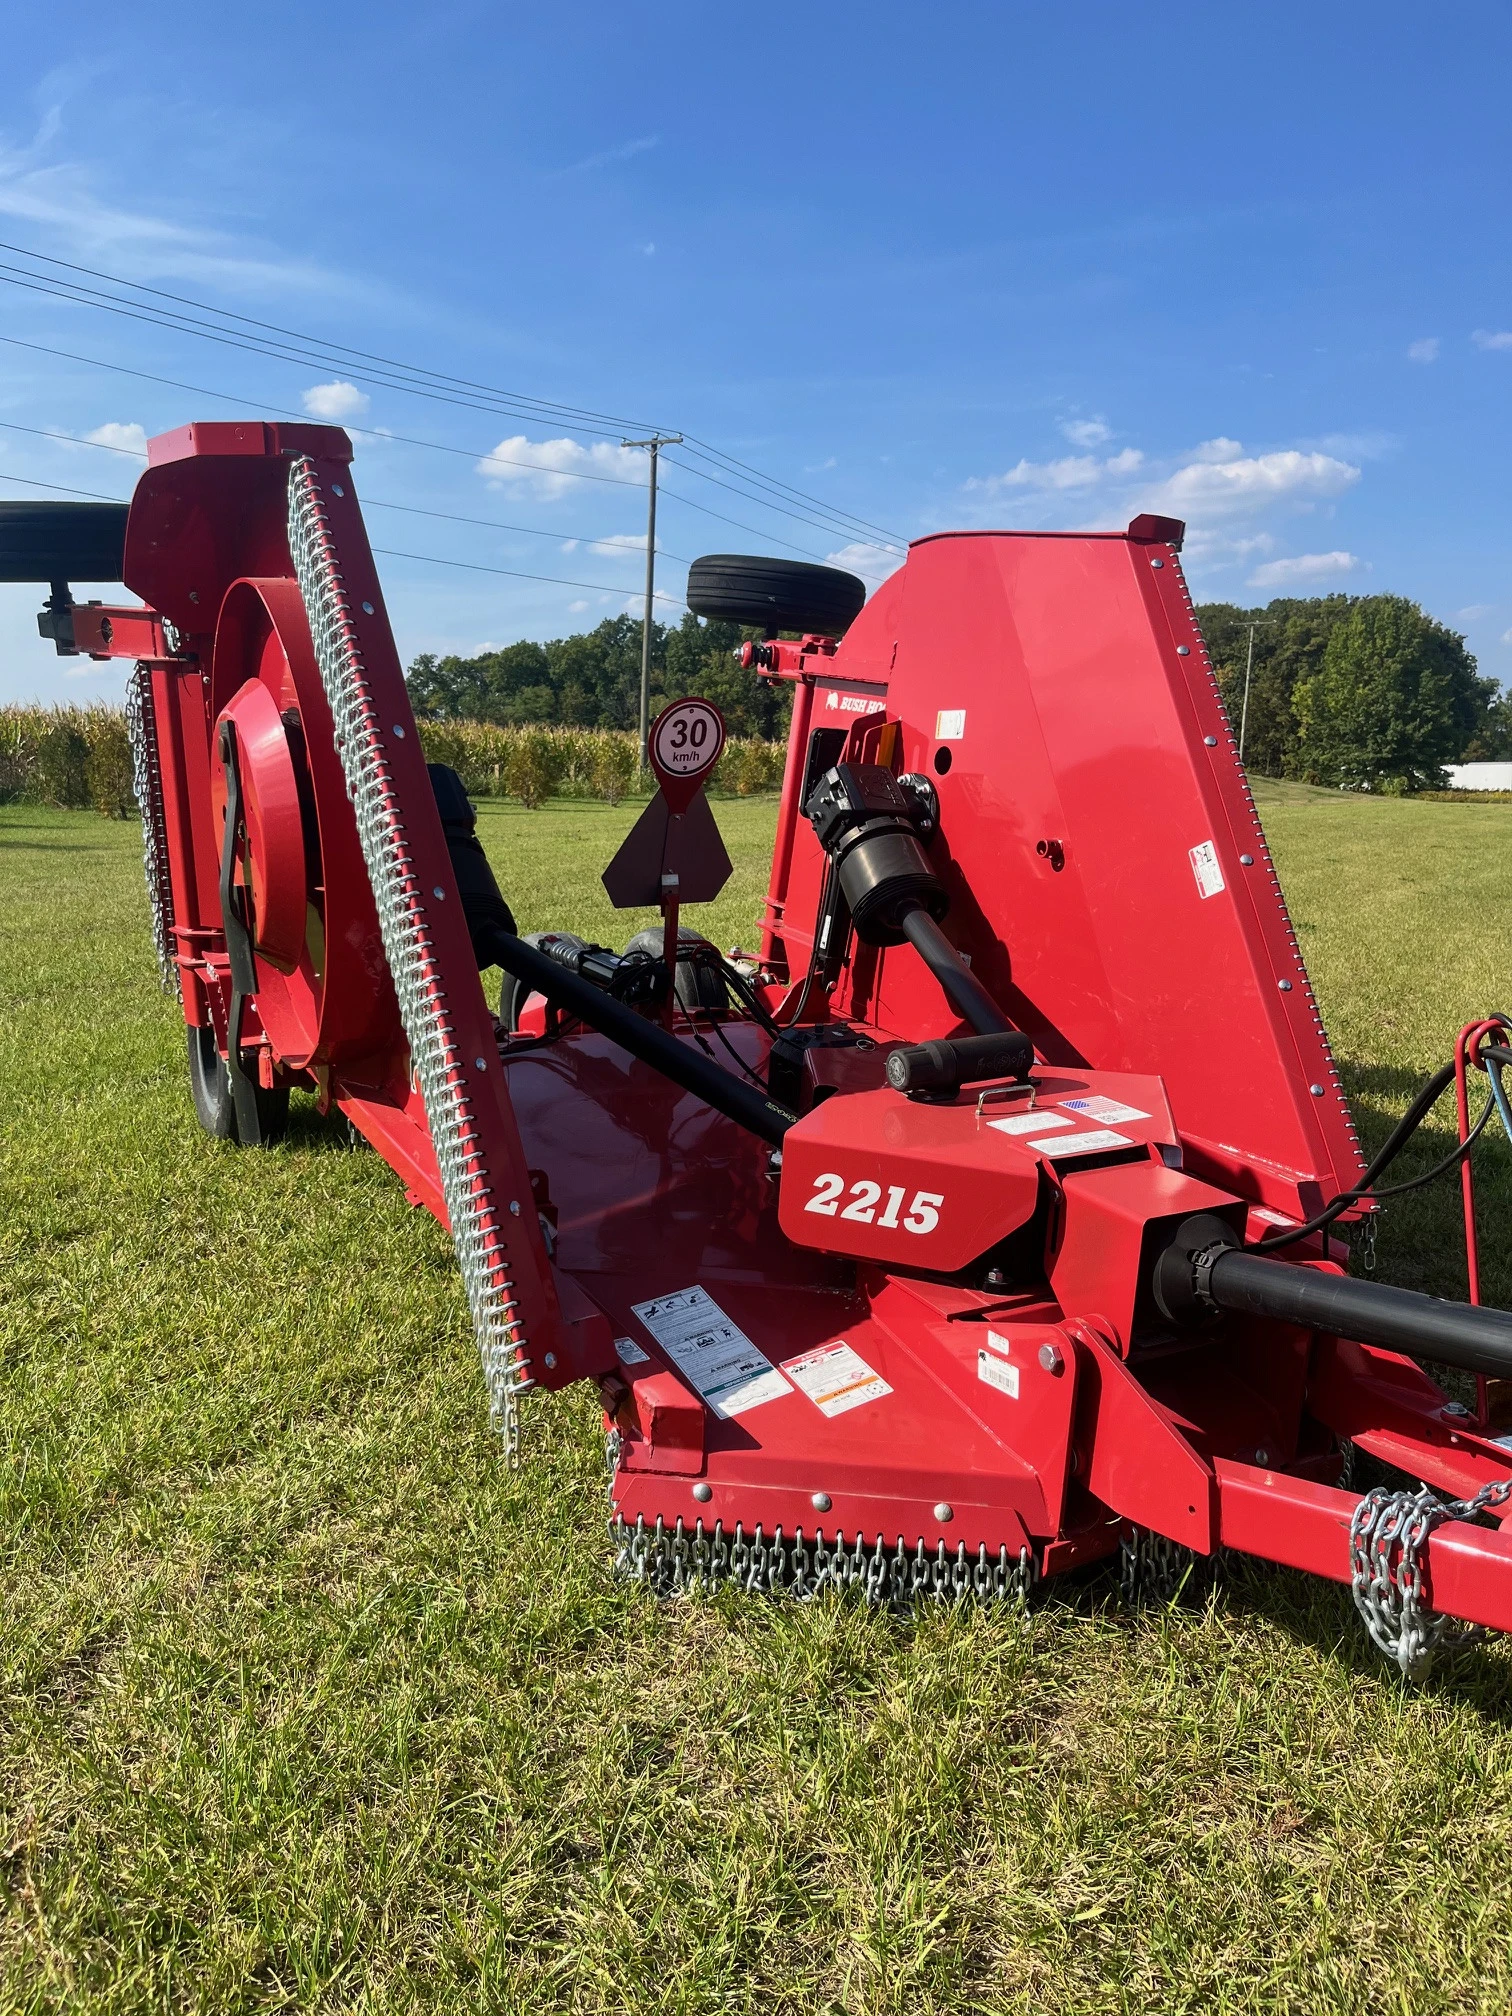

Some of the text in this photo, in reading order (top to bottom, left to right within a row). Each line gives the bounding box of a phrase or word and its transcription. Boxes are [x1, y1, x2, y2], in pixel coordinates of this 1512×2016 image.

[839, 696, 868, 713] BUSH
[670, 718, 707, 748] 30
[672, 751, 700, 762] km/h
[804, 1173, 945, 1235] 2215
[716, 1358, 742, 1370] WARNING
